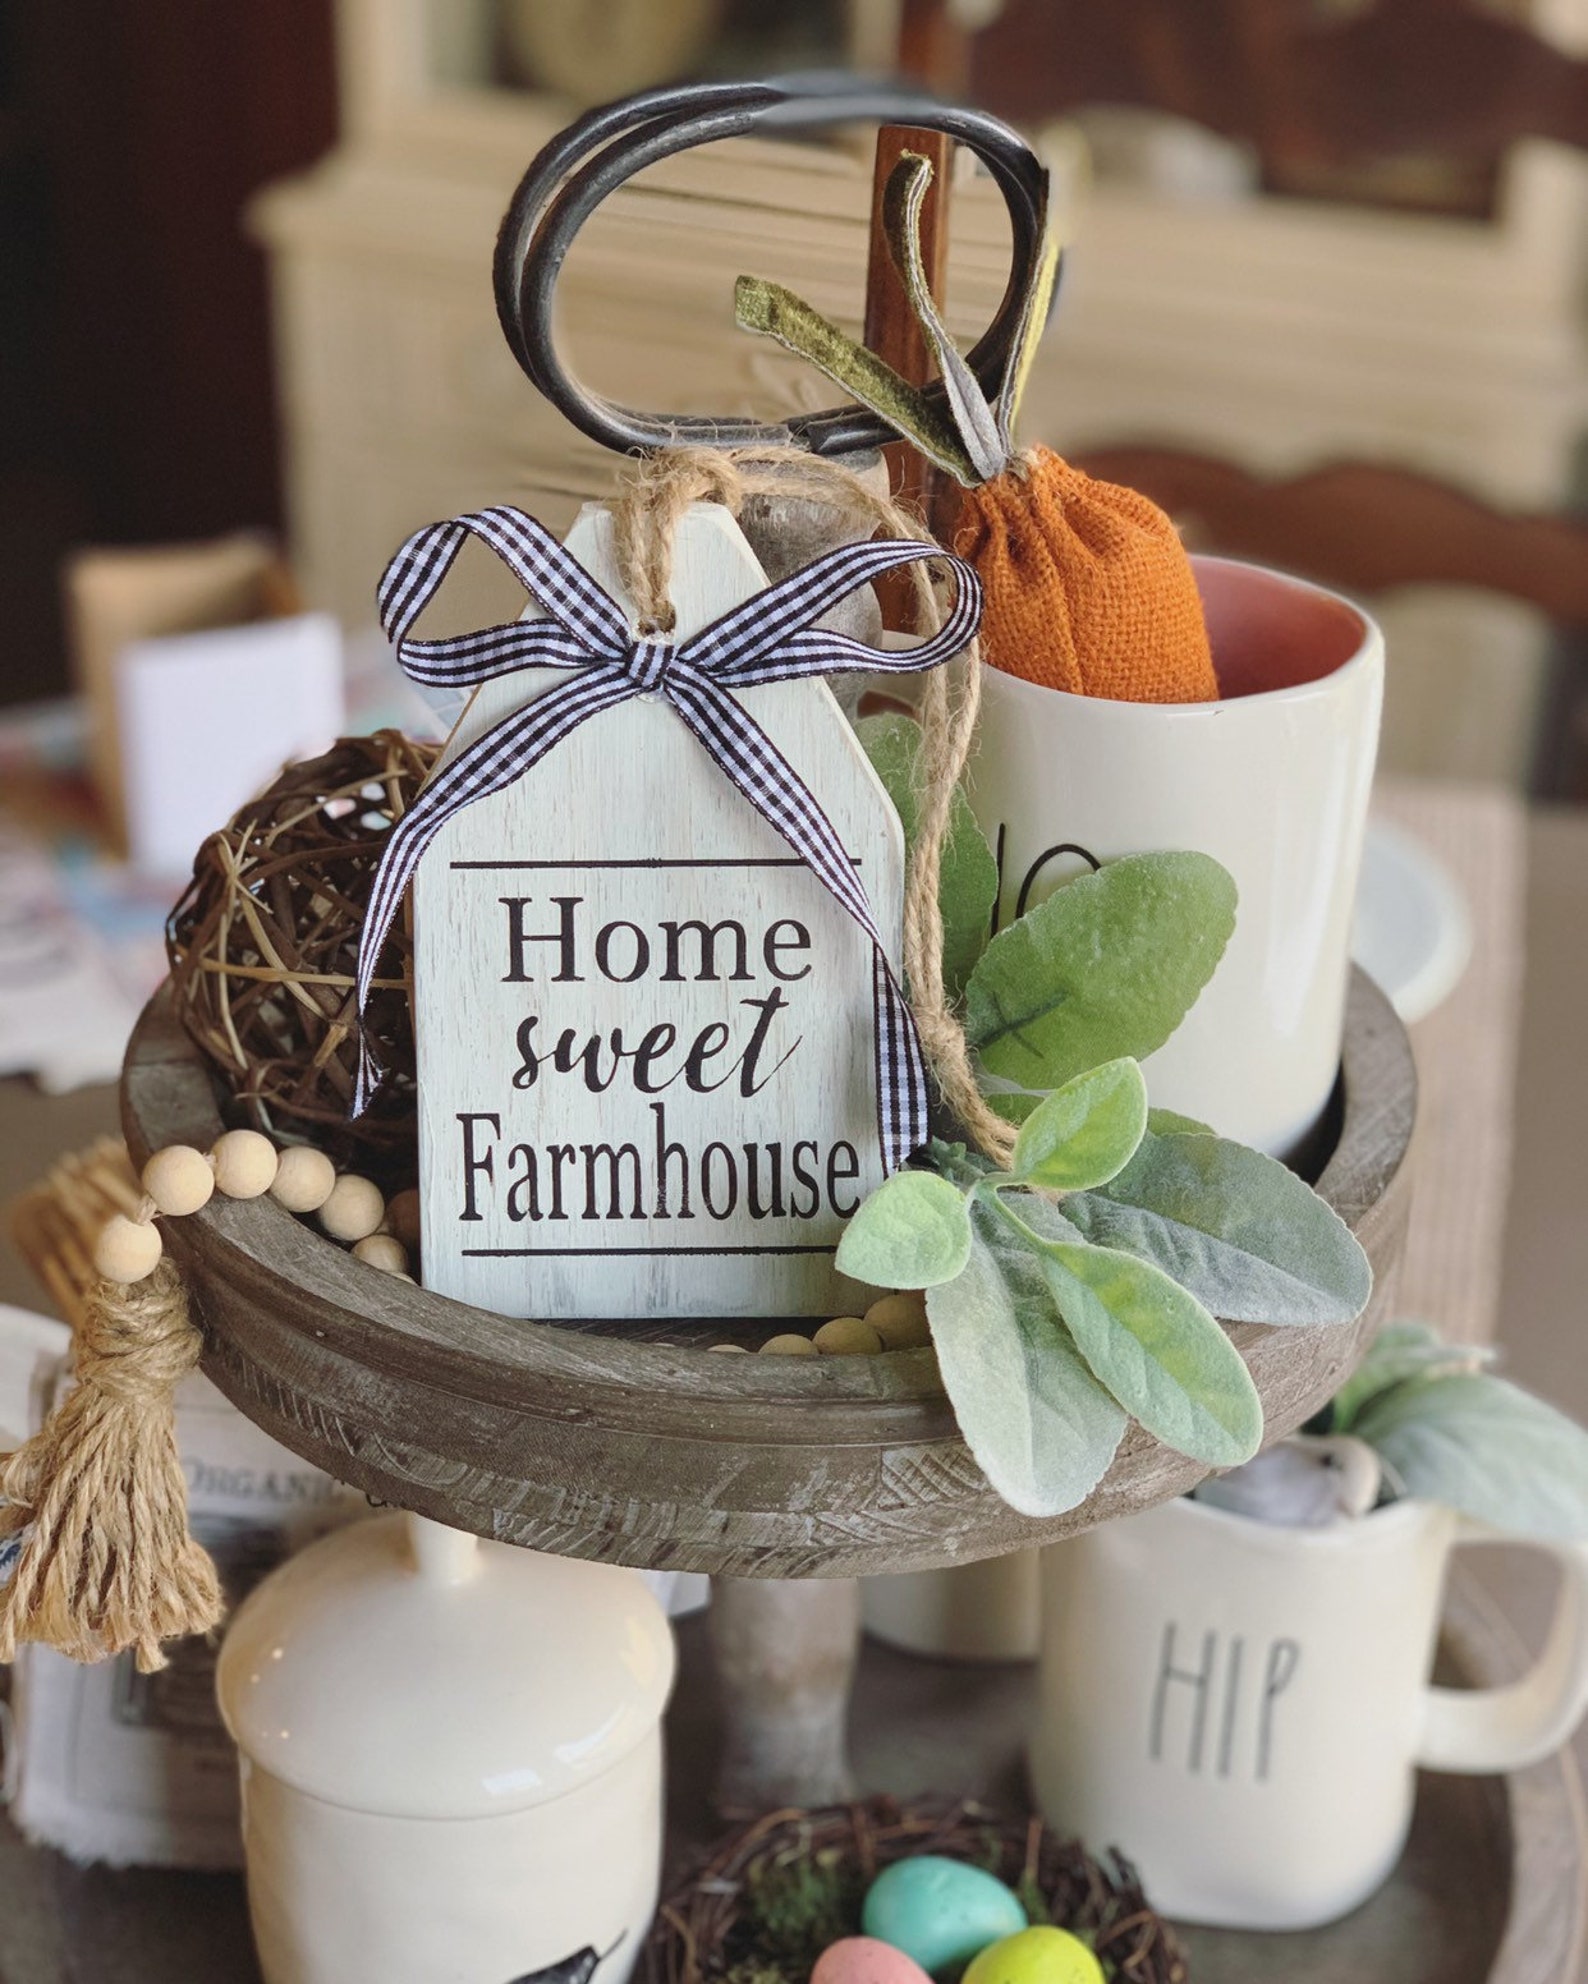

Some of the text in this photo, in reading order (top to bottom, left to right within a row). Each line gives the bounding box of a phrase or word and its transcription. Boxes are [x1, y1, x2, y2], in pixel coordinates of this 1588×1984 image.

[498, 896, 812, 982] Home
[511, 986, 803, 1098] sweet
[456, 1102, 860, 1222] Farmhouse
[1148, 1620, 1301, 1782] HIP
